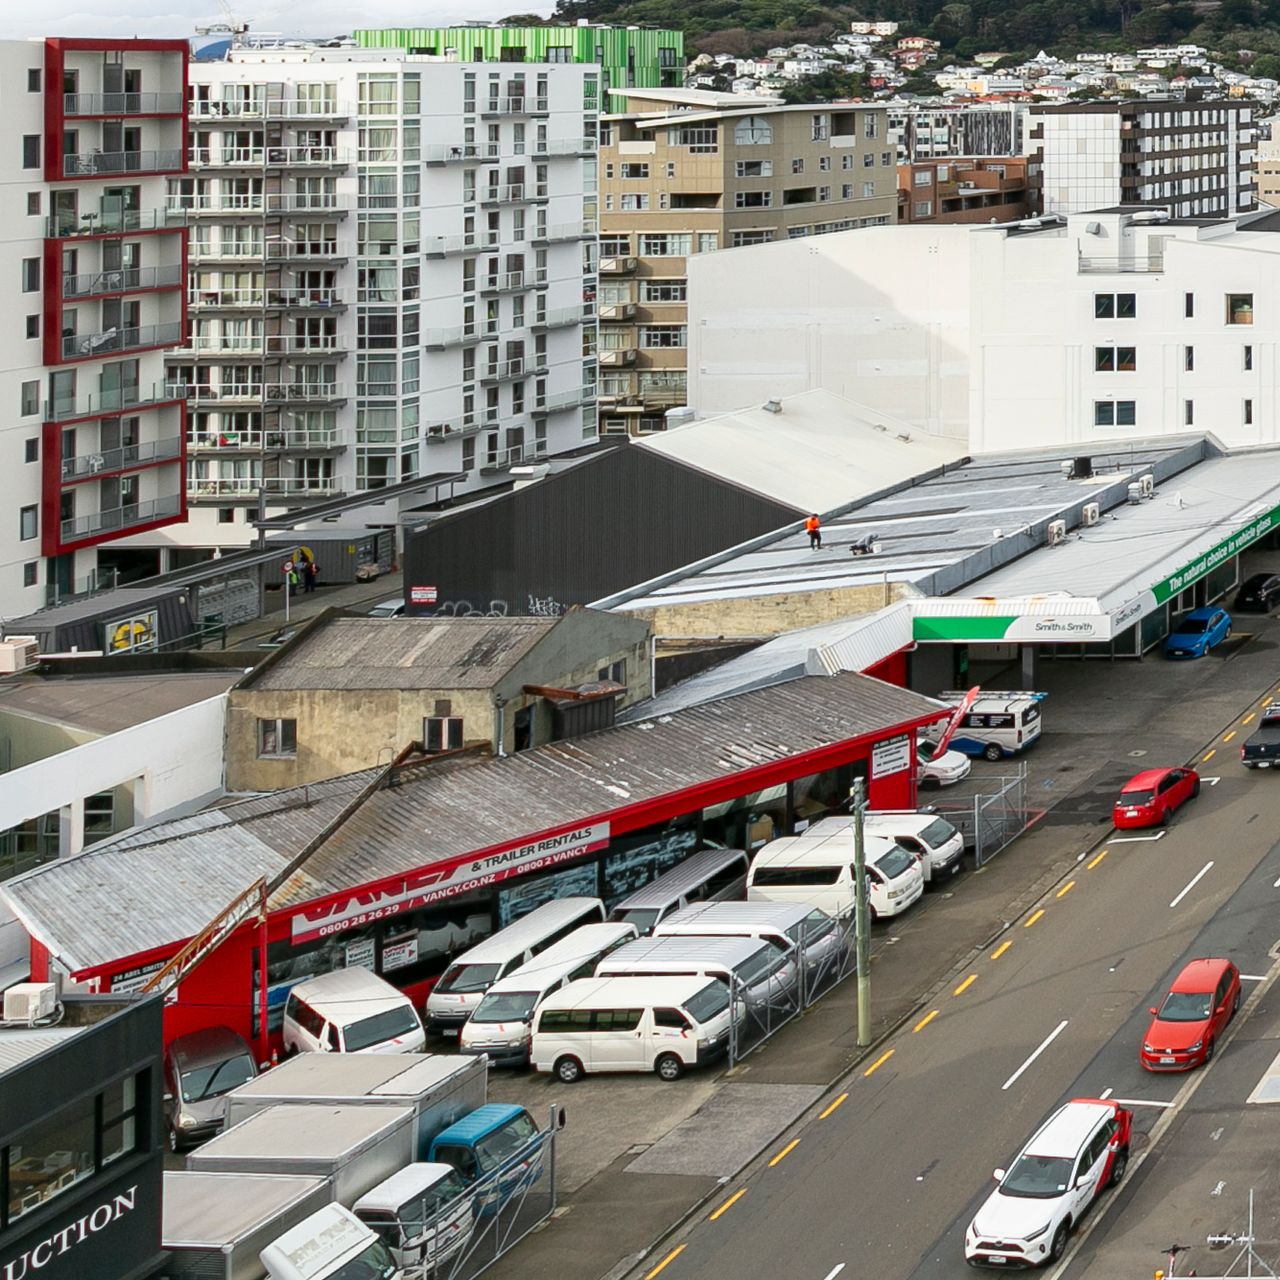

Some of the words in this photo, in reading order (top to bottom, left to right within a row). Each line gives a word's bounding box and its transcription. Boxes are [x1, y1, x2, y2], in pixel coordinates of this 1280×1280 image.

[1169, 576, 1183, 592] The
[1184, 558, 1206, 583] natural
[1206, 547, 1228, 567] choice
[1228, 540, 1236, 553] in
[1236, 527, 1255, 547] vehicle
[1256, 517, 1272, 537] glass
[1035, 622, 1061, 632] Smith
[1067, 622, 1093, 632] Smith
[471, 862, 482, 872] &
[485, 846, 535, 868] TRAILER
[538, 827, 592, 852] RENTALS
[319, 920, 349, 936] 0800
[351, 915, 366, 927] 28
[368, 910, 383, 921] 26
[385, 904, 400, 915] 29
[422, 873, 496, 903] VANCY.CO.NZ
[517, 859, 543, 874] 0800
[545, 856, 552, 865] 2
[553, 845, 588, 863] VANCY
[4, 1185, 138, 1280] UCTION
